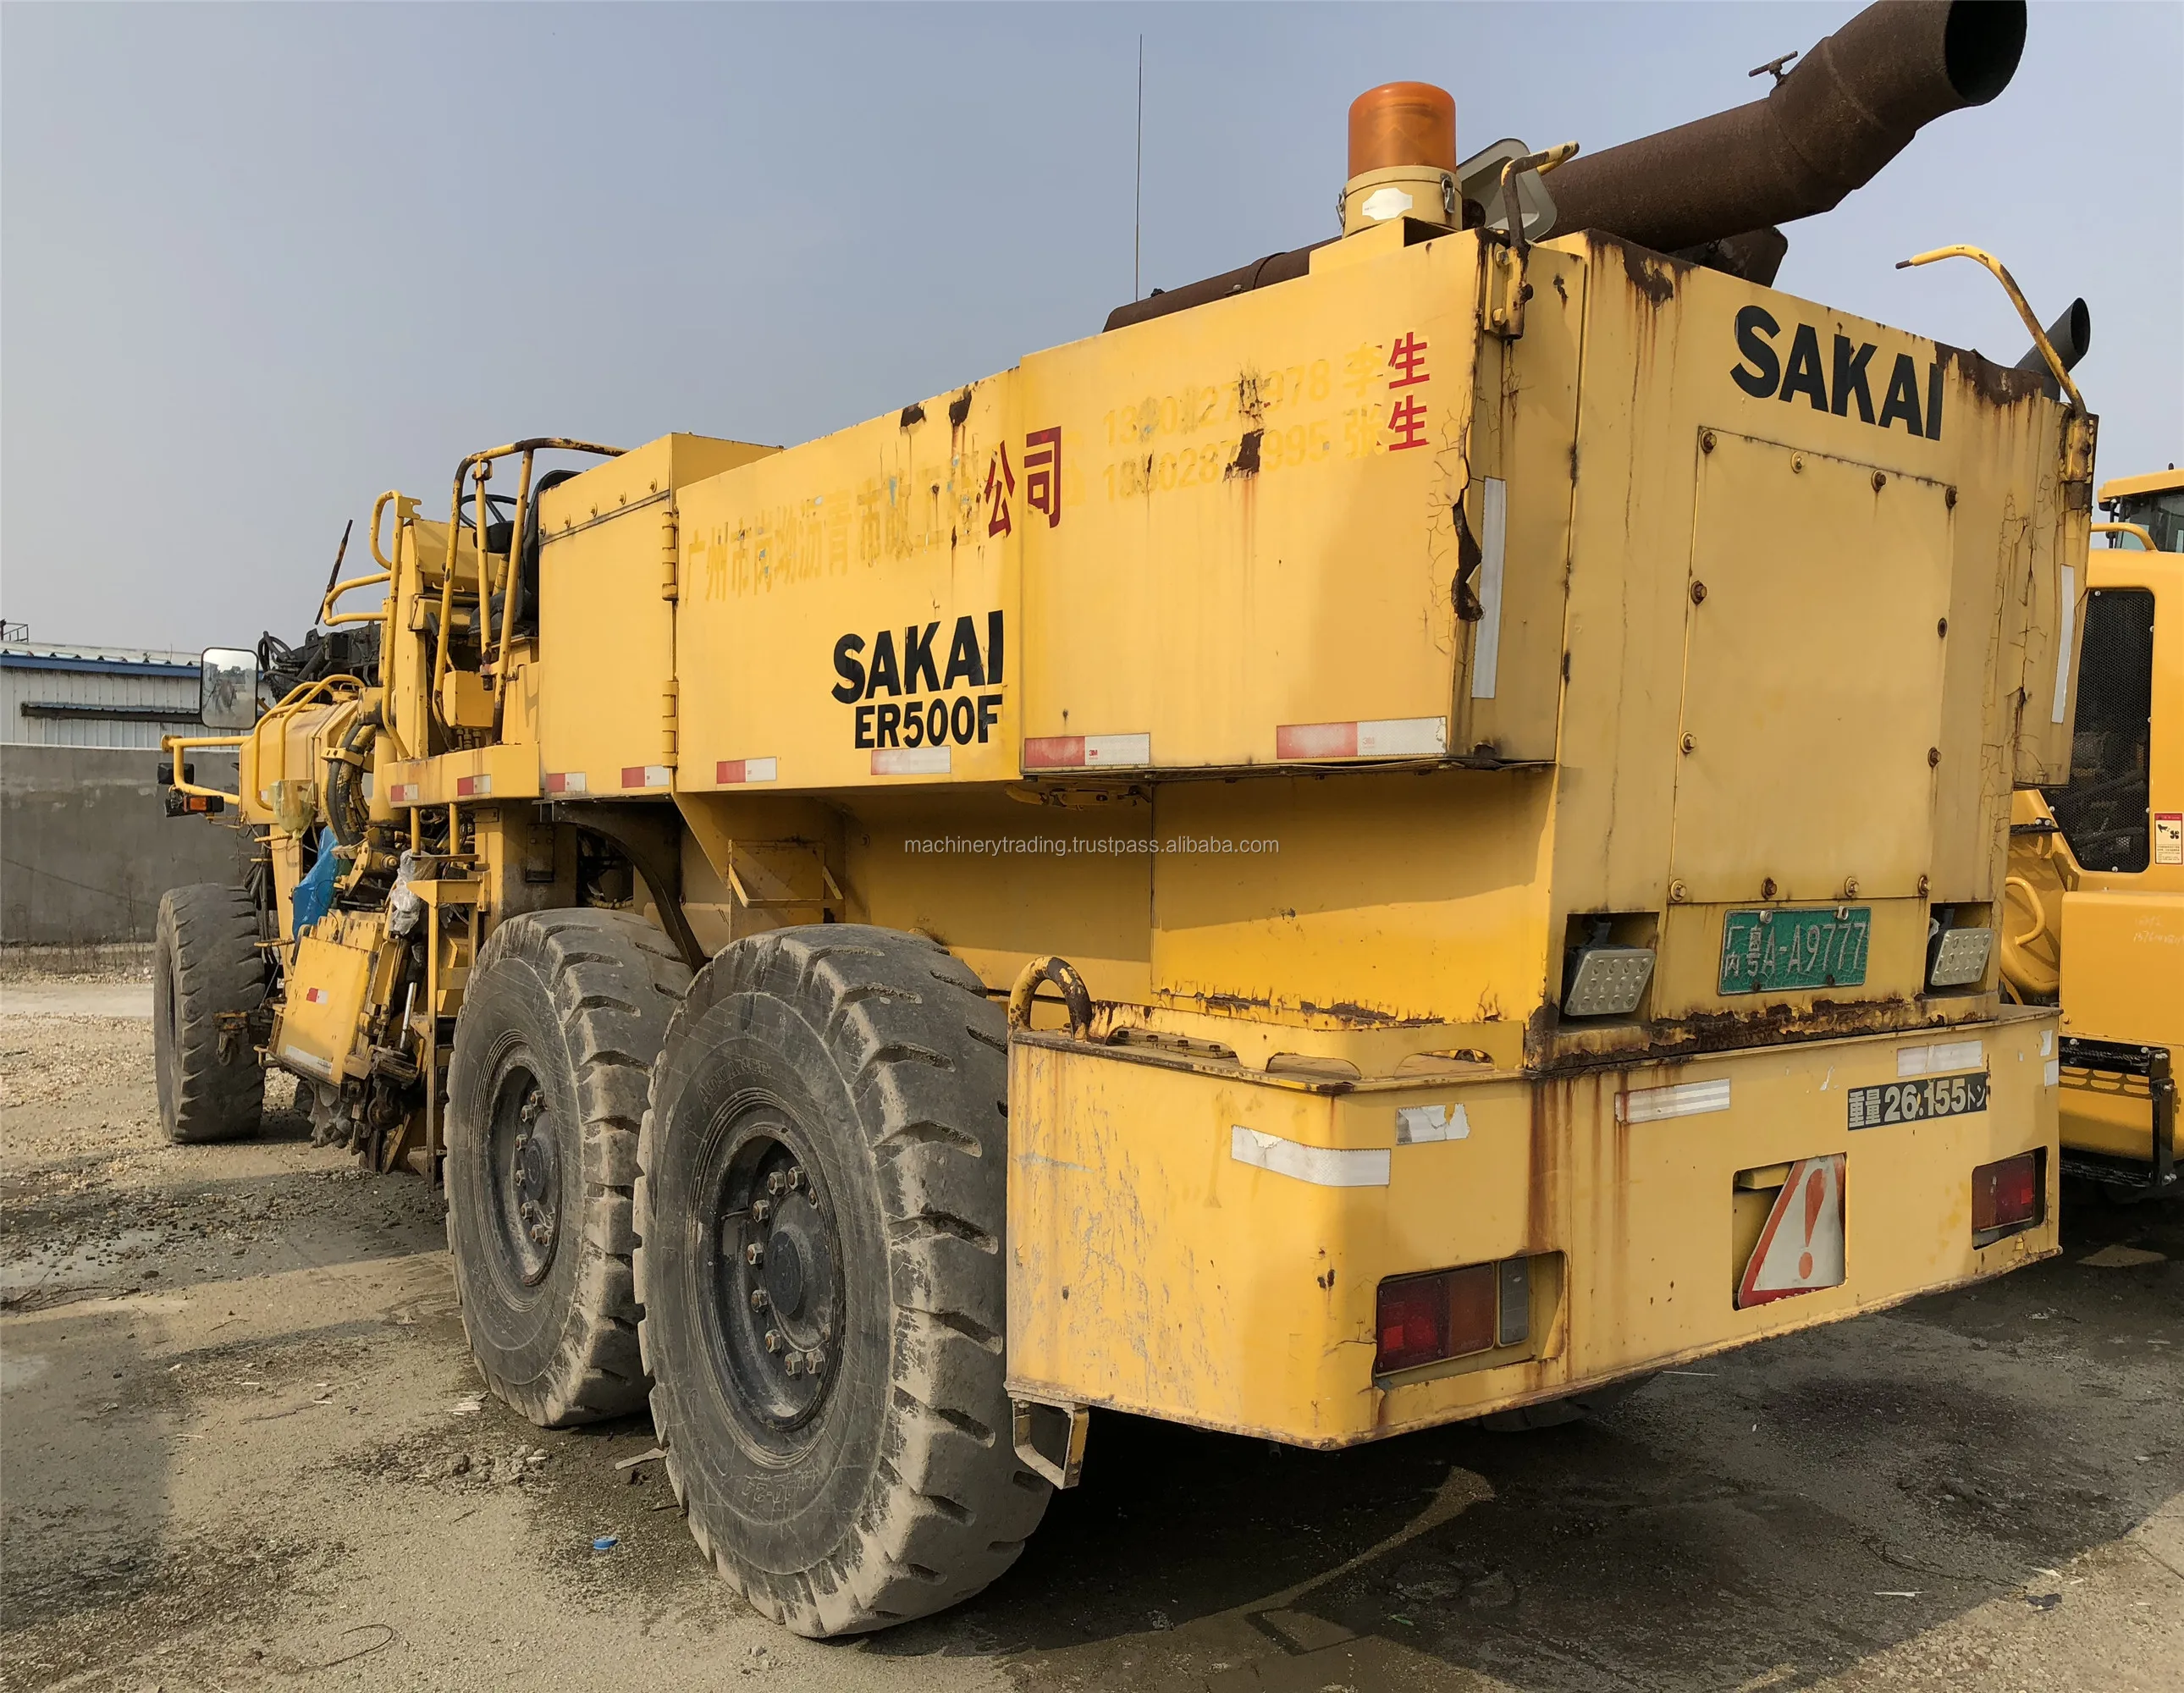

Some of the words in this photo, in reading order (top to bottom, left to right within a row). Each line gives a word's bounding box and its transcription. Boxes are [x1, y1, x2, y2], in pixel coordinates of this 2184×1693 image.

[1729, 305, 1944, 441] SAKAI
[830, 609, 1004, 704] SAKAI
[854, 694, 1003, 749] ER500F
